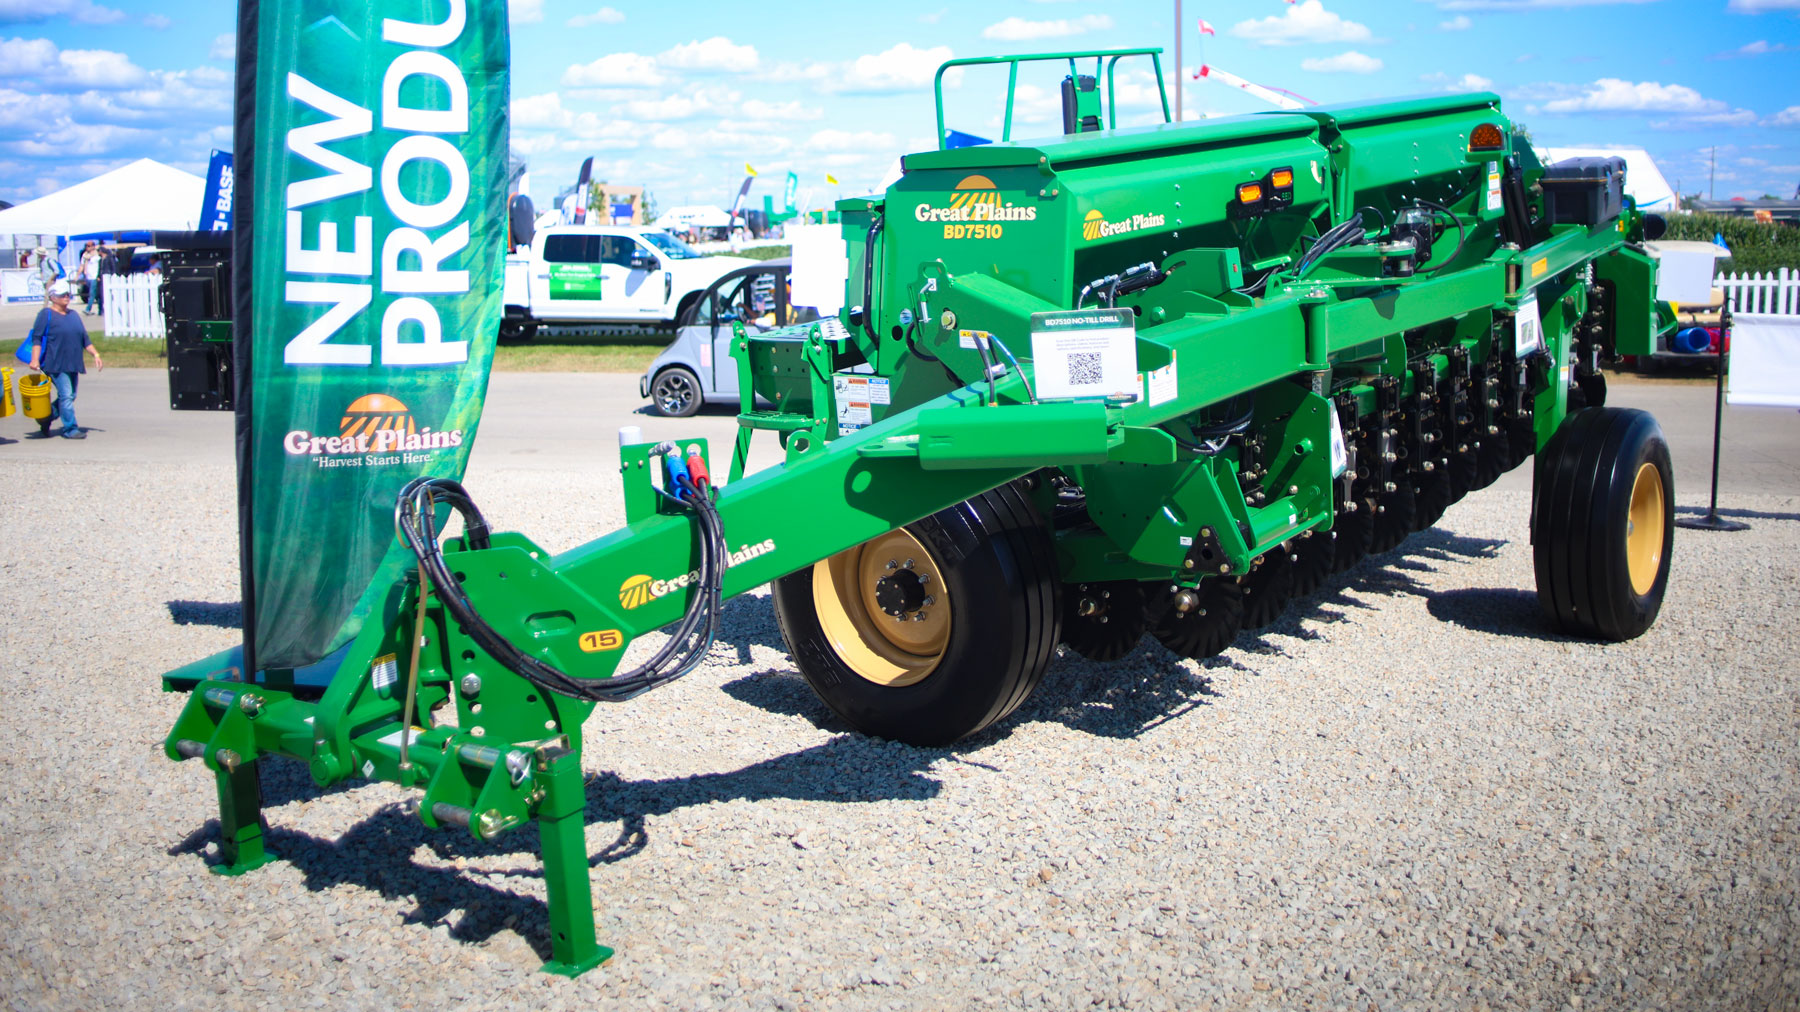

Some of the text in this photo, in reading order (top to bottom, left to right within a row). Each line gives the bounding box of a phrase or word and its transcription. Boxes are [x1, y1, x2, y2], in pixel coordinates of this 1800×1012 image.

[284, 72, 373, 364] NEW
[915, 202, 1037, 222] Great Plains
[943, 224, 1003, 239] BD7510
[1100, 212, 1165, 237] Great Plains
[1045, 315, 1119, 326] BD7510 NO-TILL DRILL
[283, 427, 463, 454] Great Plains
[365, 454, 400, 466] Starts
[650, 538, 776, 598] Grea lains
[584, 632, 618, 648] 15
